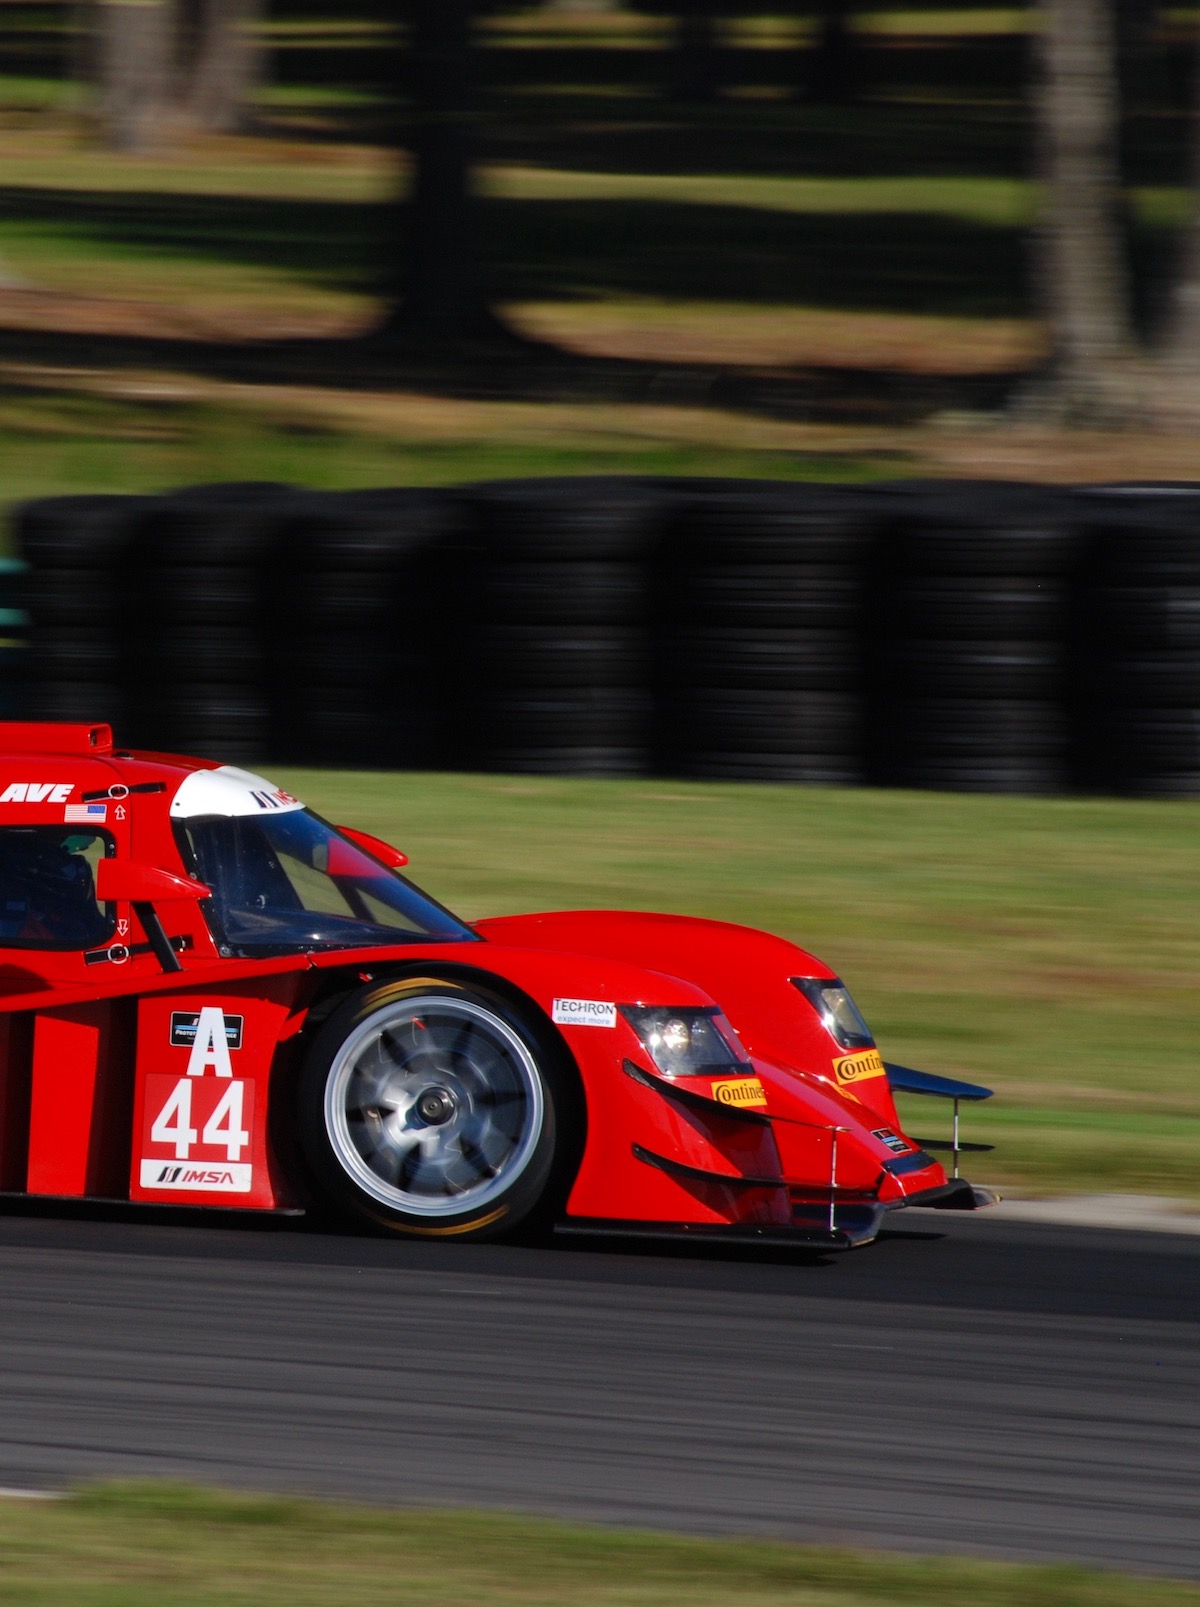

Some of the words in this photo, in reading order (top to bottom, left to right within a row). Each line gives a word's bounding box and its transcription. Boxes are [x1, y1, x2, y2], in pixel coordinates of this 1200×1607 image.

[554, 999, 614, 1015] TECHRON
[557, 1015, 587, 1024] expect
[588, 1017, 611, 1025] more
[186, 1006, 233, 1077] A
[151, 1078, 249, 1161] 44
[182, 1170, 234, 1184] IMSA
